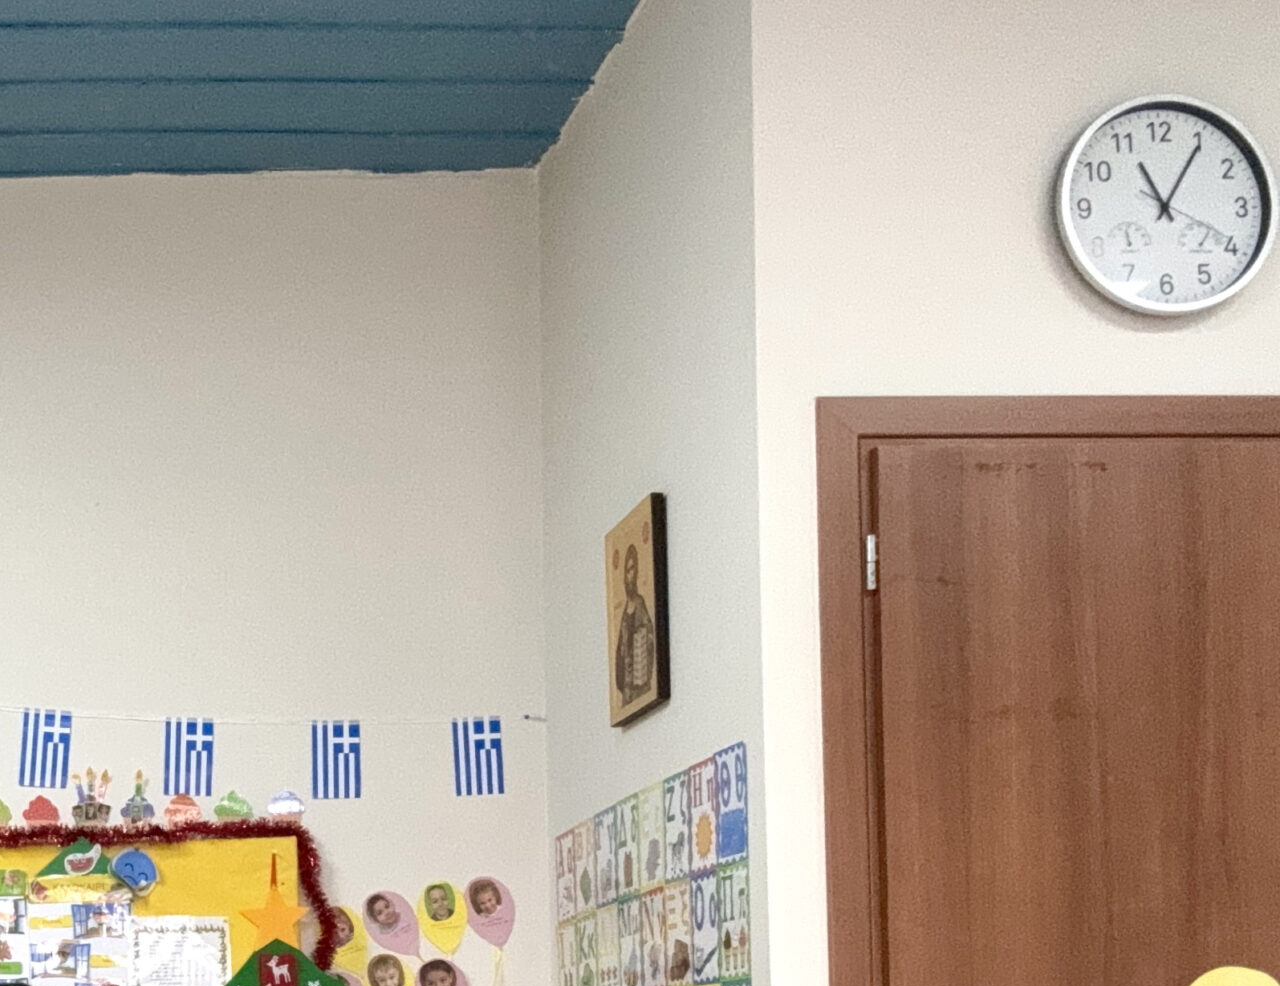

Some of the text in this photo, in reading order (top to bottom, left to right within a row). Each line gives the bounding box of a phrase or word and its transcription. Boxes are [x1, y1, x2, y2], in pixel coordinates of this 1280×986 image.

[1111, 132, 1133, 153] 11
[1146, 121, 1172, 143] 12
[1193, 131, 1202, 150] 1
[1084, 160, 1111, 182] 10
[1221, 158, 1235, 180] 2
[1076, 197, 1092, 219] 9
[1234, 196, 1249, 218] 3
[1091, 235, 1104, 258] 8
[1223, 235, 1239, 256] 4
[1121, 263, 1135, 282] 7
[1197, 263, 1212, 285] 5
[1159, 273, 1174, 295] 6
[692, 773, 702, 808] Η
[721, 761, 731, 808] Θ
[667, 786, 675, 822] Ζ
[694, 882, 705, 931] Ο
[721, 874, 735, 923] Π
